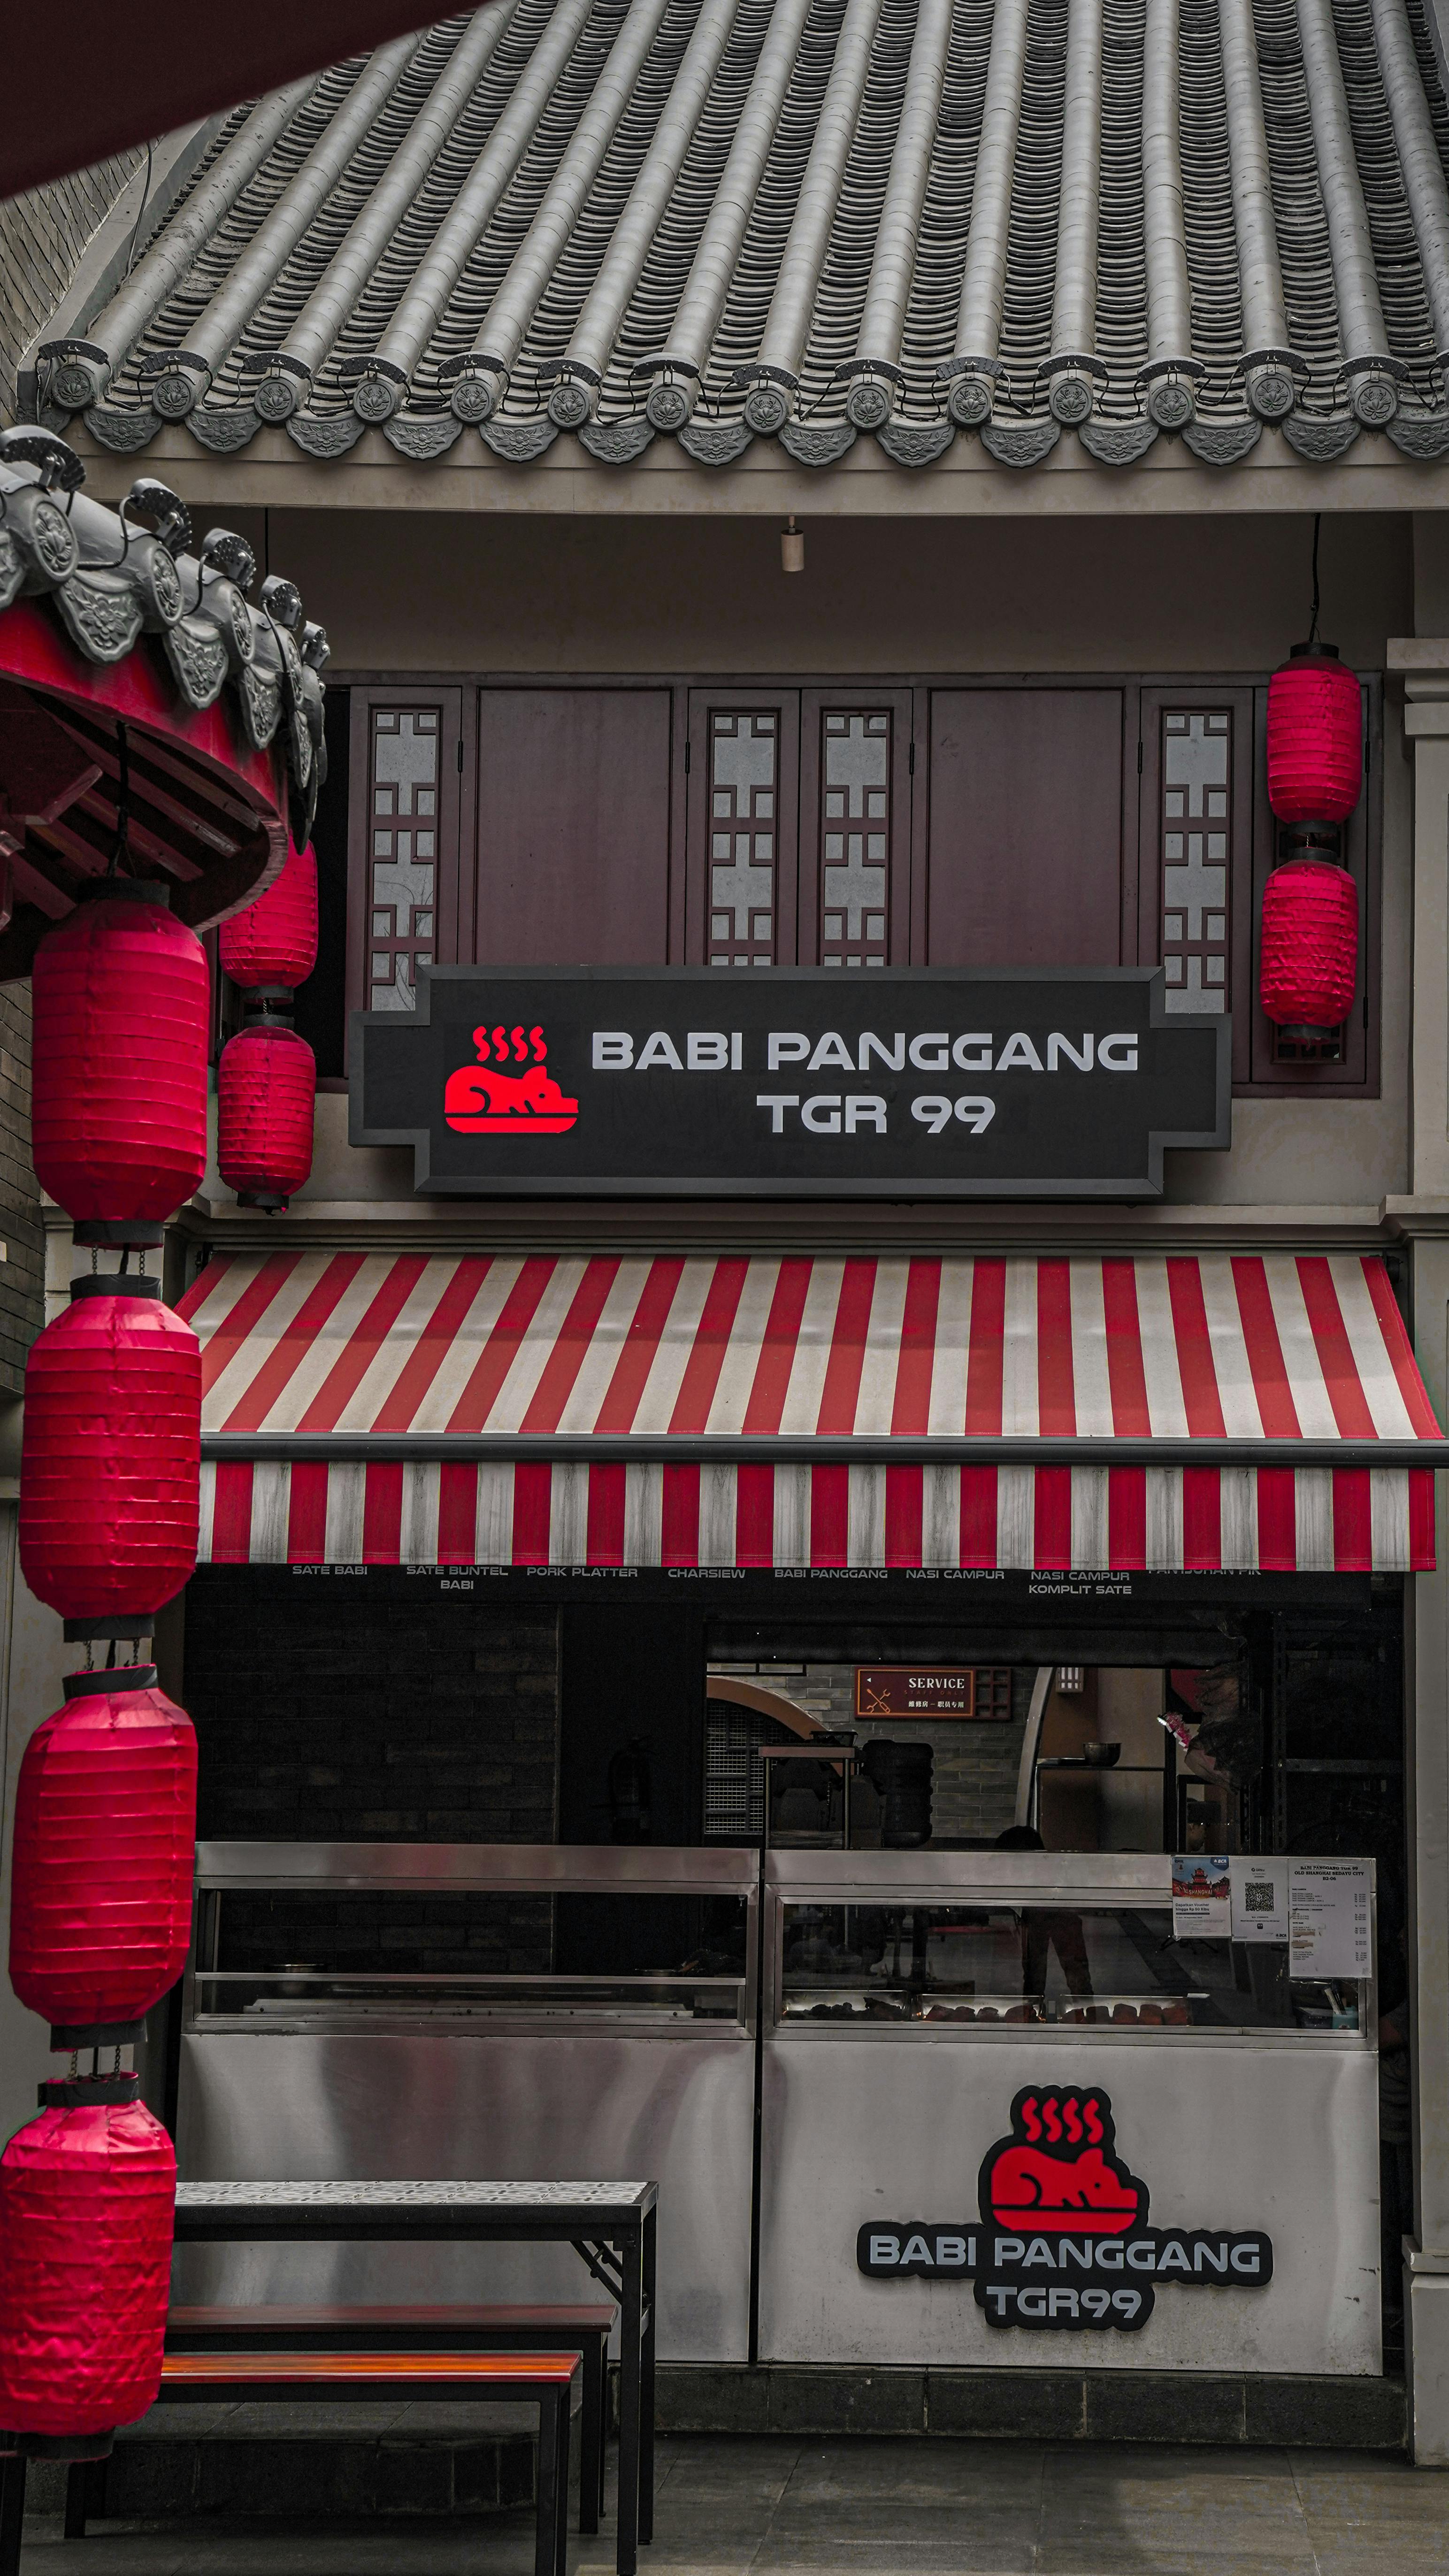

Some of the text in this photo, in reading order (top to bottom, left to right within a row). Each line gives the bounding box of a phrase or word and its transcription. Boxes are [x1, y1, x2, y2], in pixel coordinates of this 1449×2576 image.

[591, 1031, 1139, 1072] BABI PANGGANG
[756, 1095, 996, 1134] TGR 99
[292, 1565, 368, 1575] SATE BABI
[406, 1565, 508, 1576] SATE BUNTEL
[527, 1567, 638, 1577] PORK PLATTER
[668, 1569, 745, 1579] CHARSIEW
[774, 1569, 888, 1579] BABI PANGGANG
[906, 1570, 1005, 1579] NASI CAMPUR
[1031, 1571, 1130, 1581] NASI CAMPUR
[440, 1580, 474, 1589] BABI
[1029, 1585, 1132, 1594] KOMPLIT SATE
[909, 1678, 965, 1688] SERVICE
[870, 2235, 1260, 2273] BABI PANGGANG
[986, 2286, 1142, 2319] TGR99
